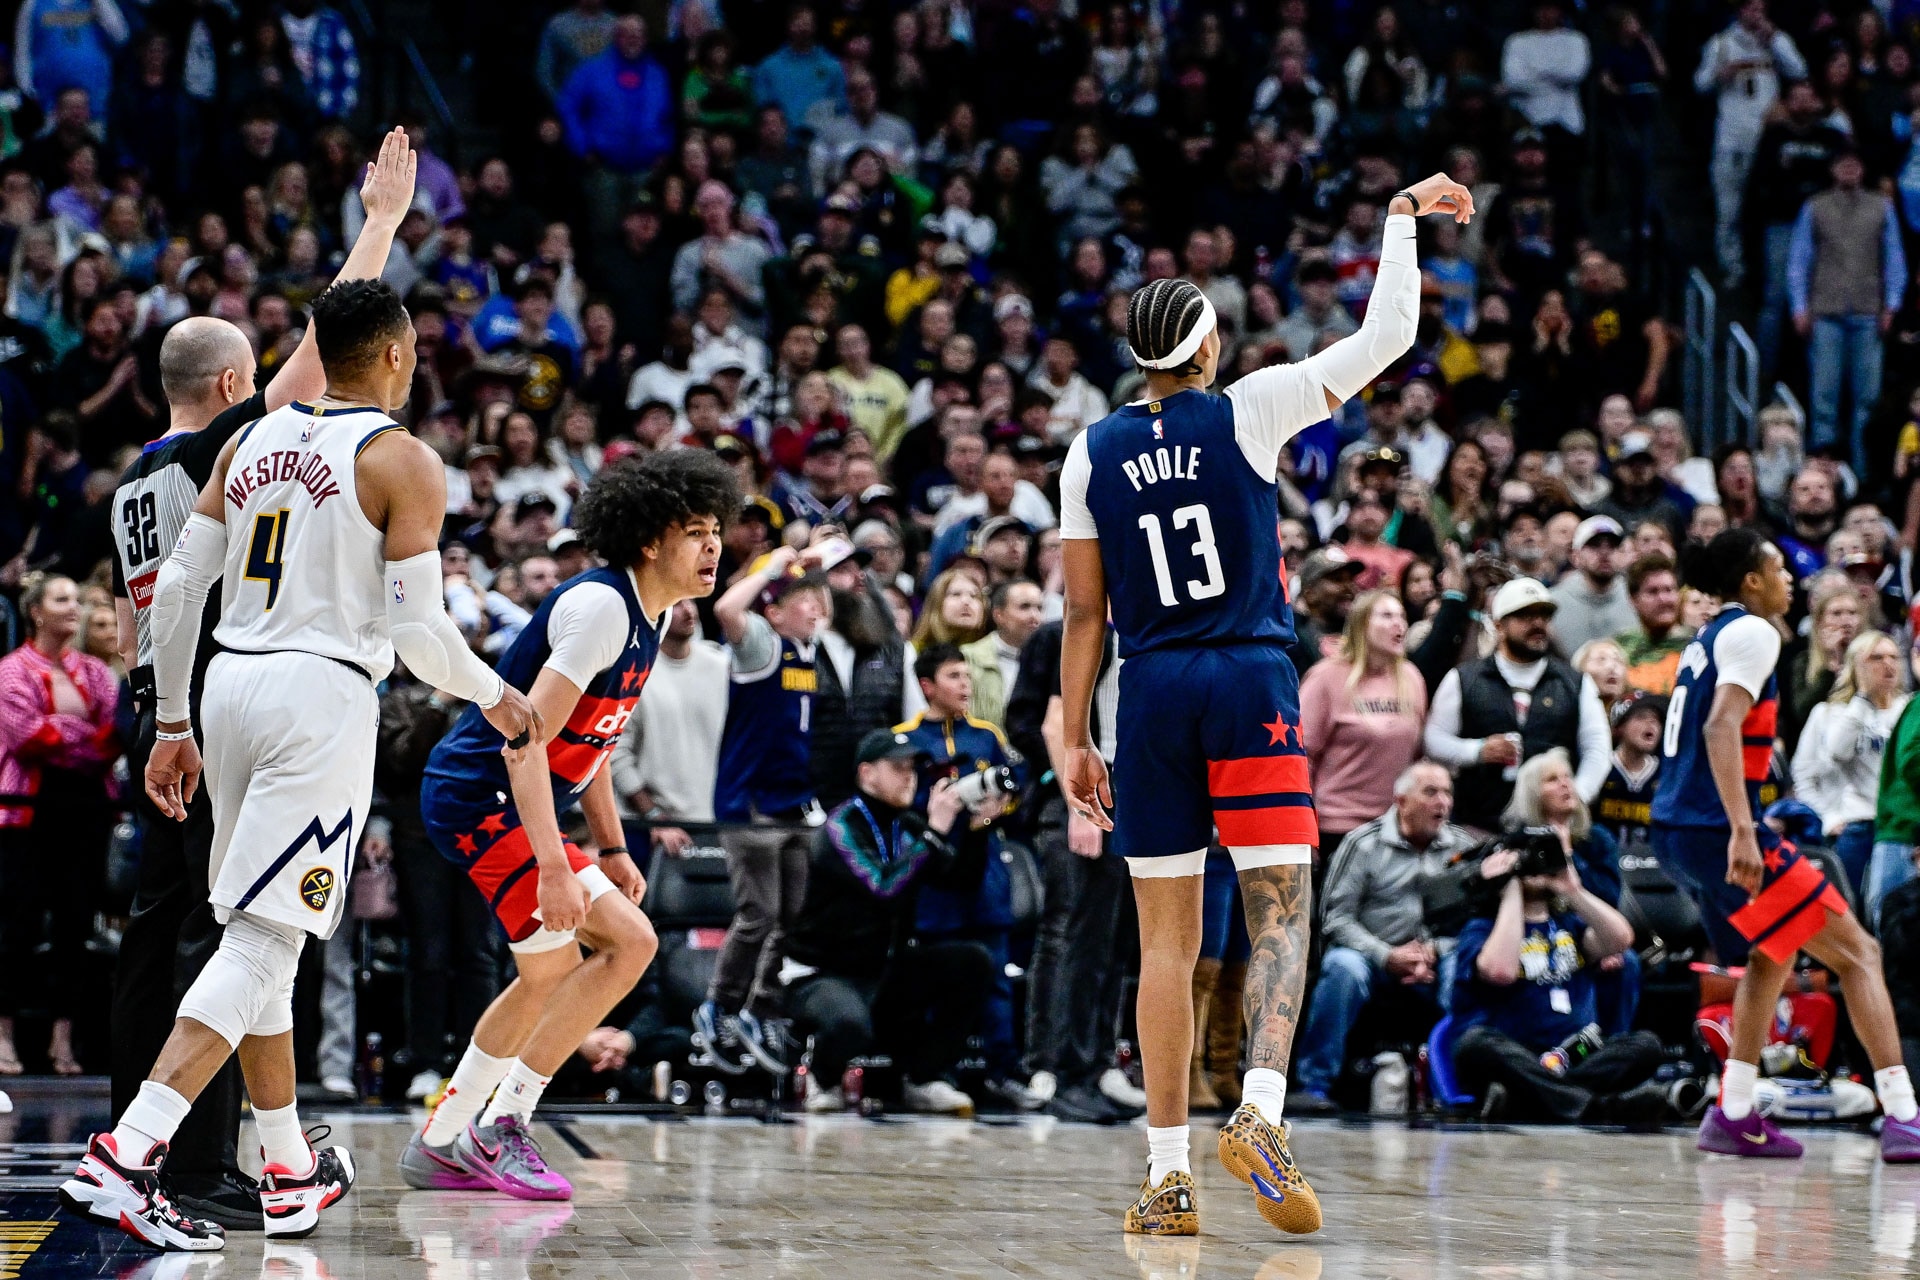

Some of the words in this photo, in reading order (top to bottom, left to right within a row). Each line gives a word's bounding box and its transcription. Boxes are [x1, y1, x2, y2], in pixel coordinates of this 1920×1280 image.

[1121, 445, 1202, 492] POOLE
[123, 491, 160, 567] 32
[243, 507, 292, 613] 4
[1138, 503, 1226, 607] 13
